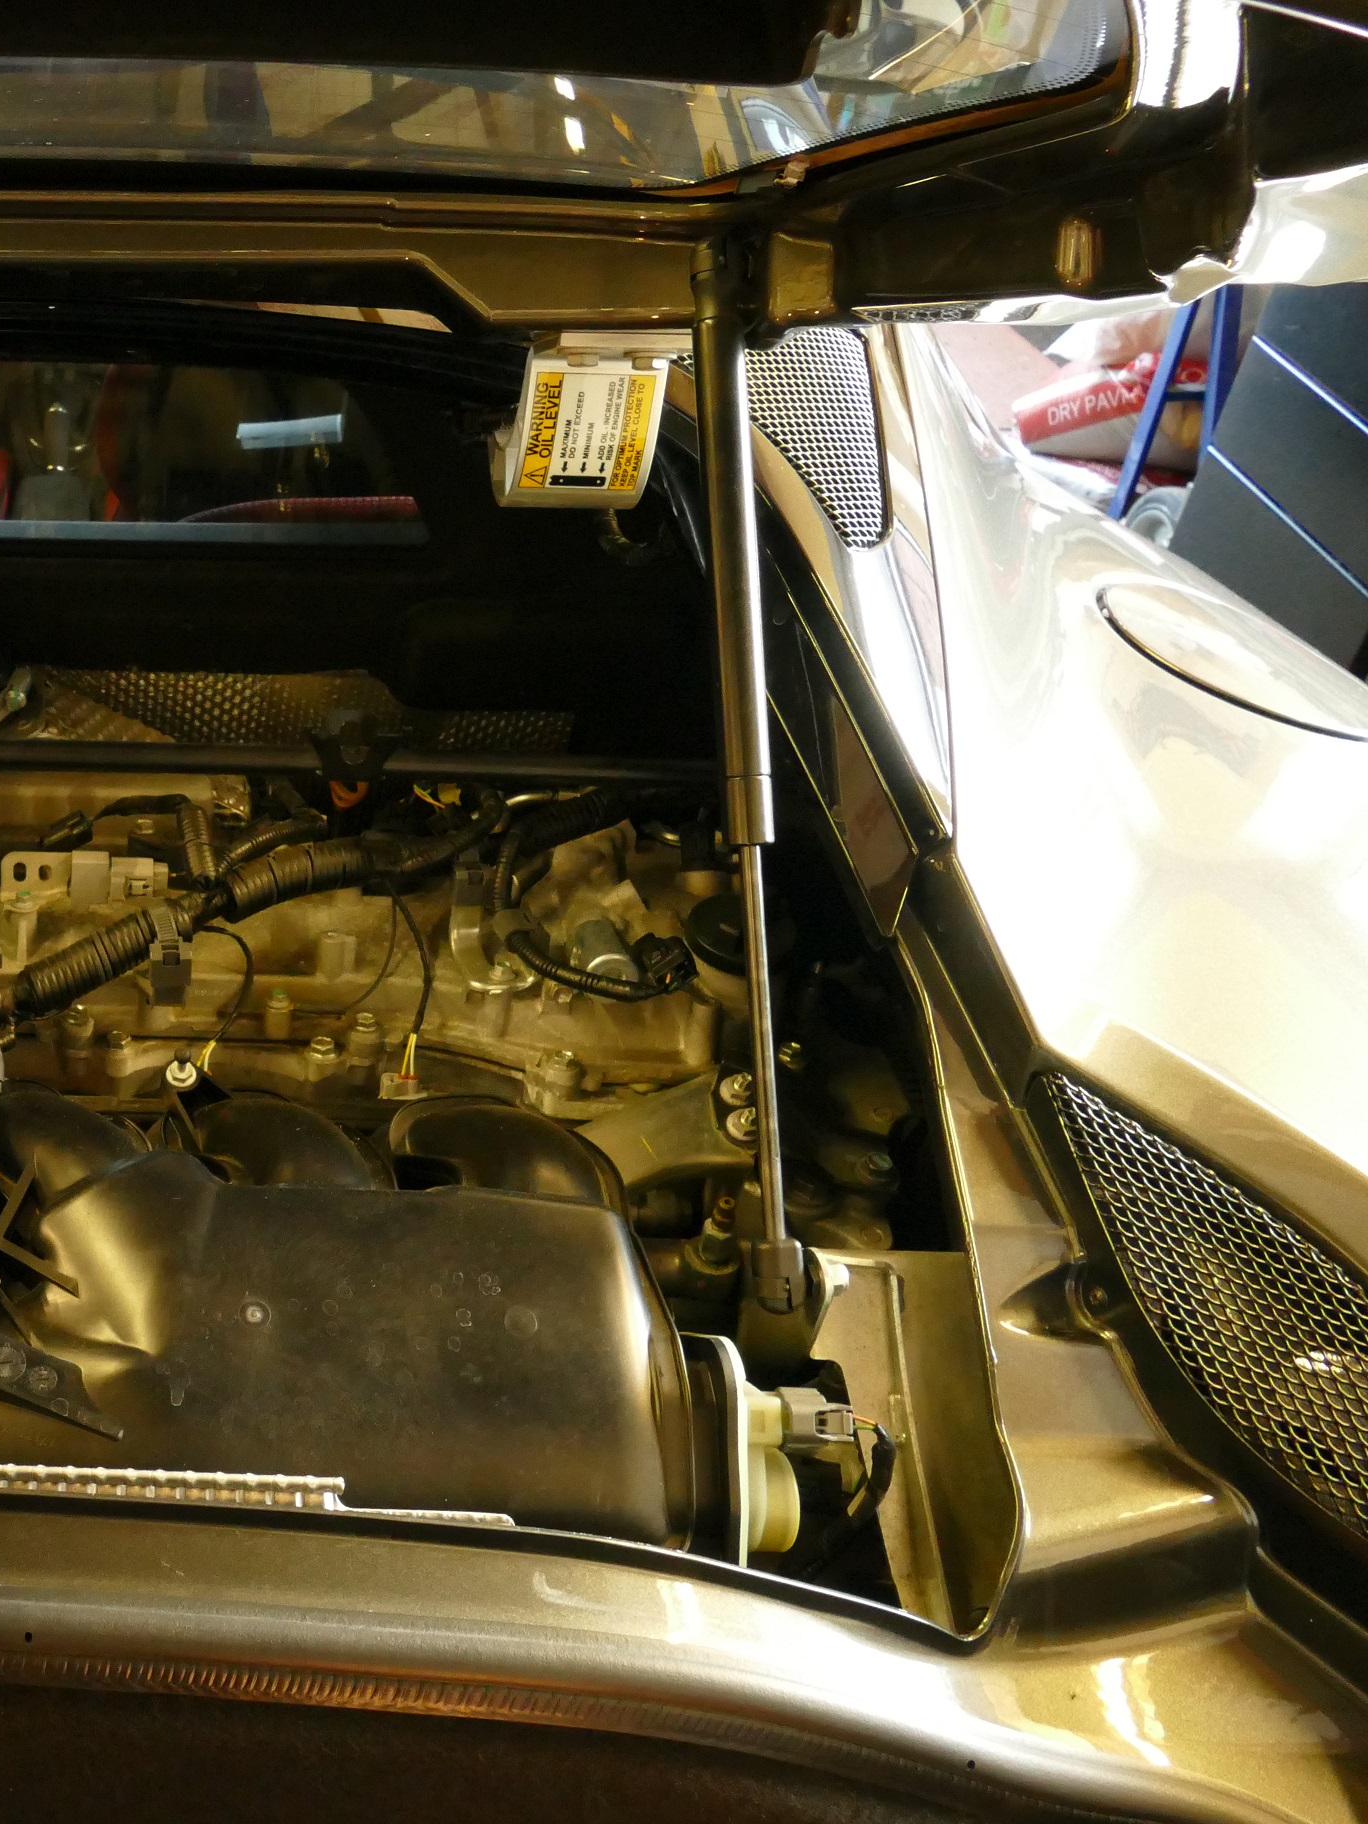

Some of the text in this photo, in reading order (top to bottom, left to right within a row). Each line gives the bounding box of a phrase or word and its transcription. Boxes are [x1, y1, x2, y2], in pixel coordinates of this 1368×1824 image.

[526, 382, 549, 457] WARNING
[539, 380, 562, 458] OIL LEVEL
[568, 391, 585, 459] DO NOT EXCEED
[603, 381, 616, 426] INCREASED
[606, 377, 626, 461] RISK OF ENGINE WEAR
[1047, 400, 1082, 426] DRY
[560, 419, 572, 459] MAXIMUM
[582, 422, 595, 459] MINIMUM
[597, 445, 606, 460] ADD
[600, 431, 608, 444] OIL
[611, 379, 637, 487] FOR OPTIMUM PROTECTION
[618, 383, 645, 487] KEEP OIL LEVEL CLOSE TO
[627, 450, 643, 487] TOP MARK
